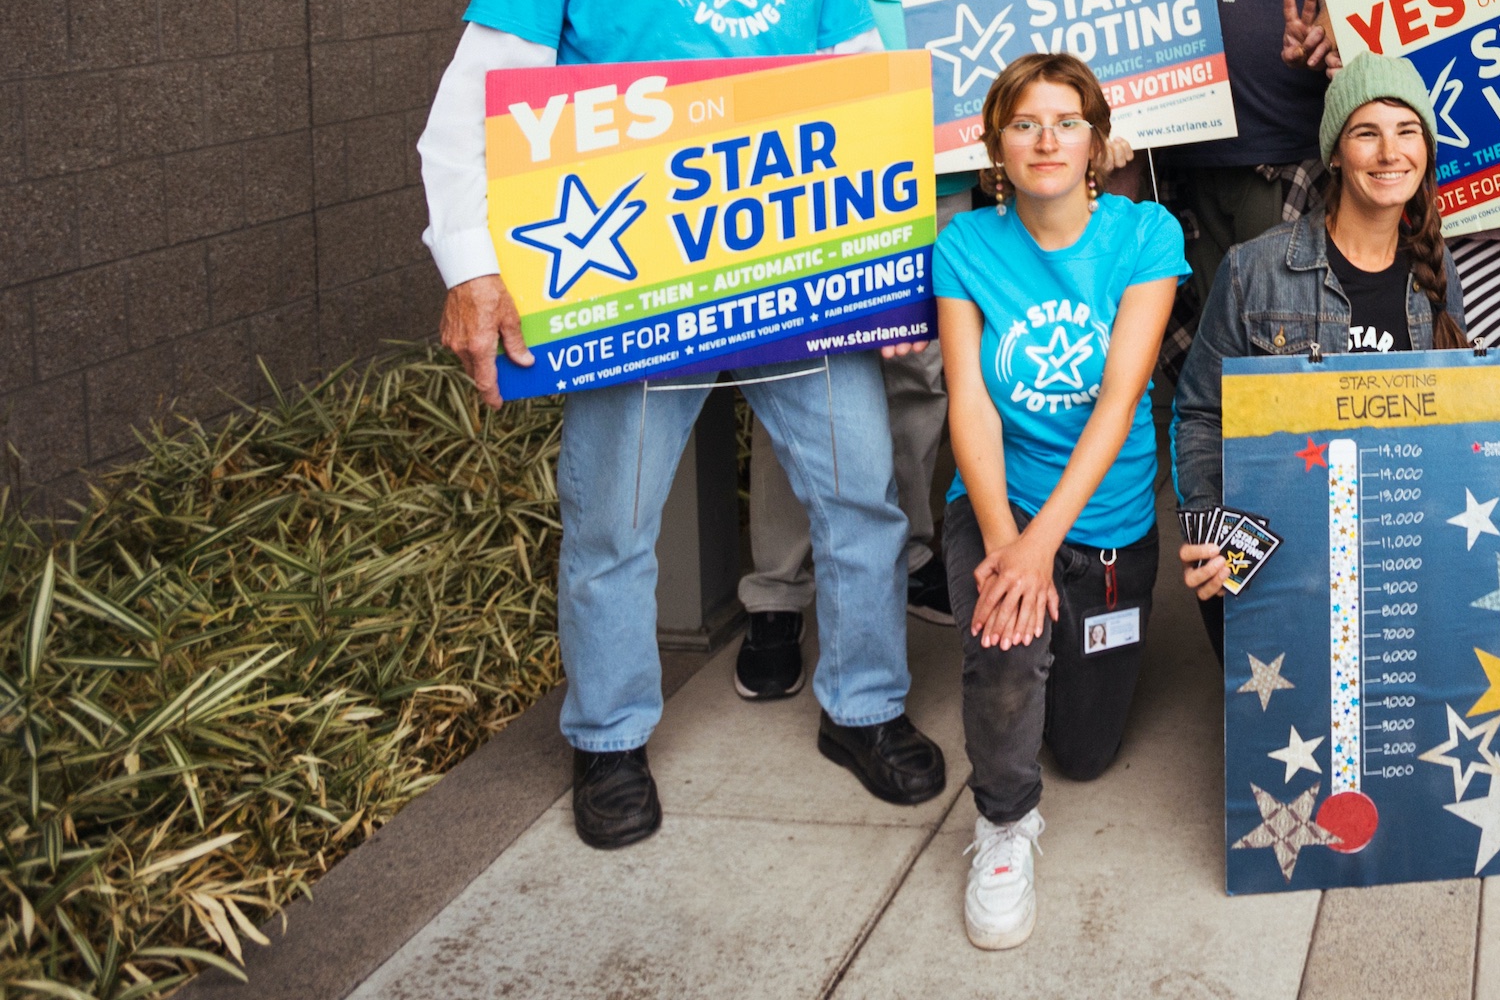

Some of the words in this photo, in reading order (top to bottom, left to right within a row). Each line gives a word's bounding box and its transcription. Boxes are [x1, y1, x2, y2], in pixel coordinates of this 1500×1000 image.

[694, 2, 781, 39] VOTING
[1155, 40, 1206, 64] RUNOFF
[1128, 61, 1213, 100] VOTING!
[508, 75, 674, 162] YES
[689, 97, 724, 123] ON
[1137, 119, 1222, 137] www.starlane.us
[668, 121, 836, 201] STAR
[671, 161, 918, 264] VOTING
[1444, 221, 1459, 230] VOTE
[1460, 214, 1477, 224] YOUR
[550, 301, 618, 334] SCORE
[639, 281, 693, 312] THEN
[714, 248, 823, 292] AUTOMATIC
[842, 226, 912, 259] RUNOFF
[548, 337, 614, 371] VOTE
[621, 323, 670, 353] FOR
[676, 285, 797, 341] BETTER
[804, 253, 924, 306] VOTING!
[1027, 299, 1090, 328] STAR
[572, 372, 594, 386] VOTE
[597, 366, 621, 378] YOUR
[623, 351, 679, 372] CONSCIENCE!
[699, 337, 726, 352] NEVER
[728, 331, 755, 345] WASTE
[758, 324, 780, 336] YOUR
[781, 317, 804, 330] VOTE!
[825, 307, 842, 318] FAIR
[844, 289, 910, 313] REPRESENTATION!
[807, 322, 928, 352] www.starlane.us
[1348, 326, 1394, 354] TAR
[1340, 376, 1381, 390] STAR
[1384, 374, 1436, 388] VOTING
[1337, 393, 1437, 420] EUGENE
[1230, 536, 1264, 560] VOTING
[1234, 530, 1259, 547] STAR
[1381, 535, 1421, 548] 11,000
